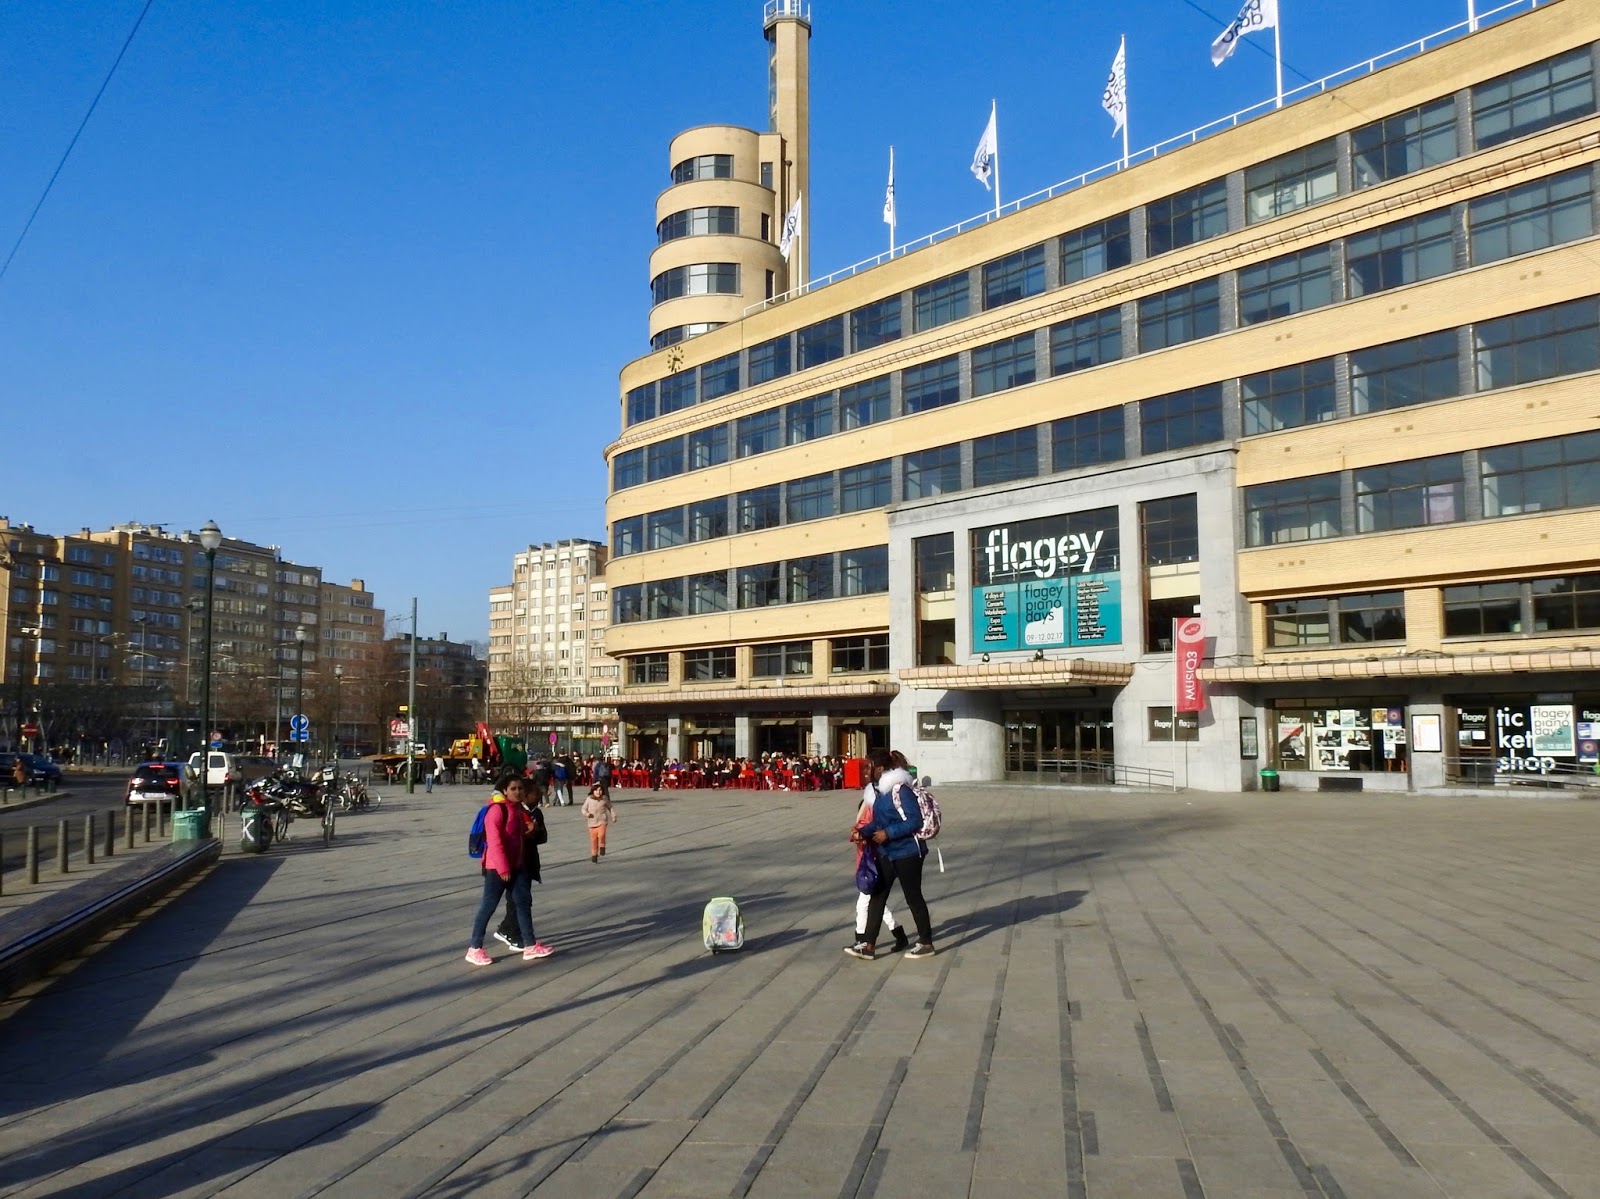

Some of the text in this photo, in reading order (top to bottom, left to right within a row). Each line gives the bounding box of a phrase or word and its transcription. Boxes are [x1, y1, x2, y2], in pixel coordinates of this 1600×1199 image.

[985, 528, 1104, 578] flagey
[1025, 584, 1063, 600] flagey
[1026, 599, 1062, 614] piano
[1026, 611, 1055, 625] days
[1185, 651, 1197, 700] MUSIQ3
[1462, 713, 1487, 722] flagey
[1497, 707, 1523, 727] tic
[1533, 707, 1570, 720] flagey
[1534, 720, 1569, 729] piano
[1534, 727, 1563, 737] days
[1498, 727, 1533, 748] ket
[1499, 749, 1556, 774] shop
